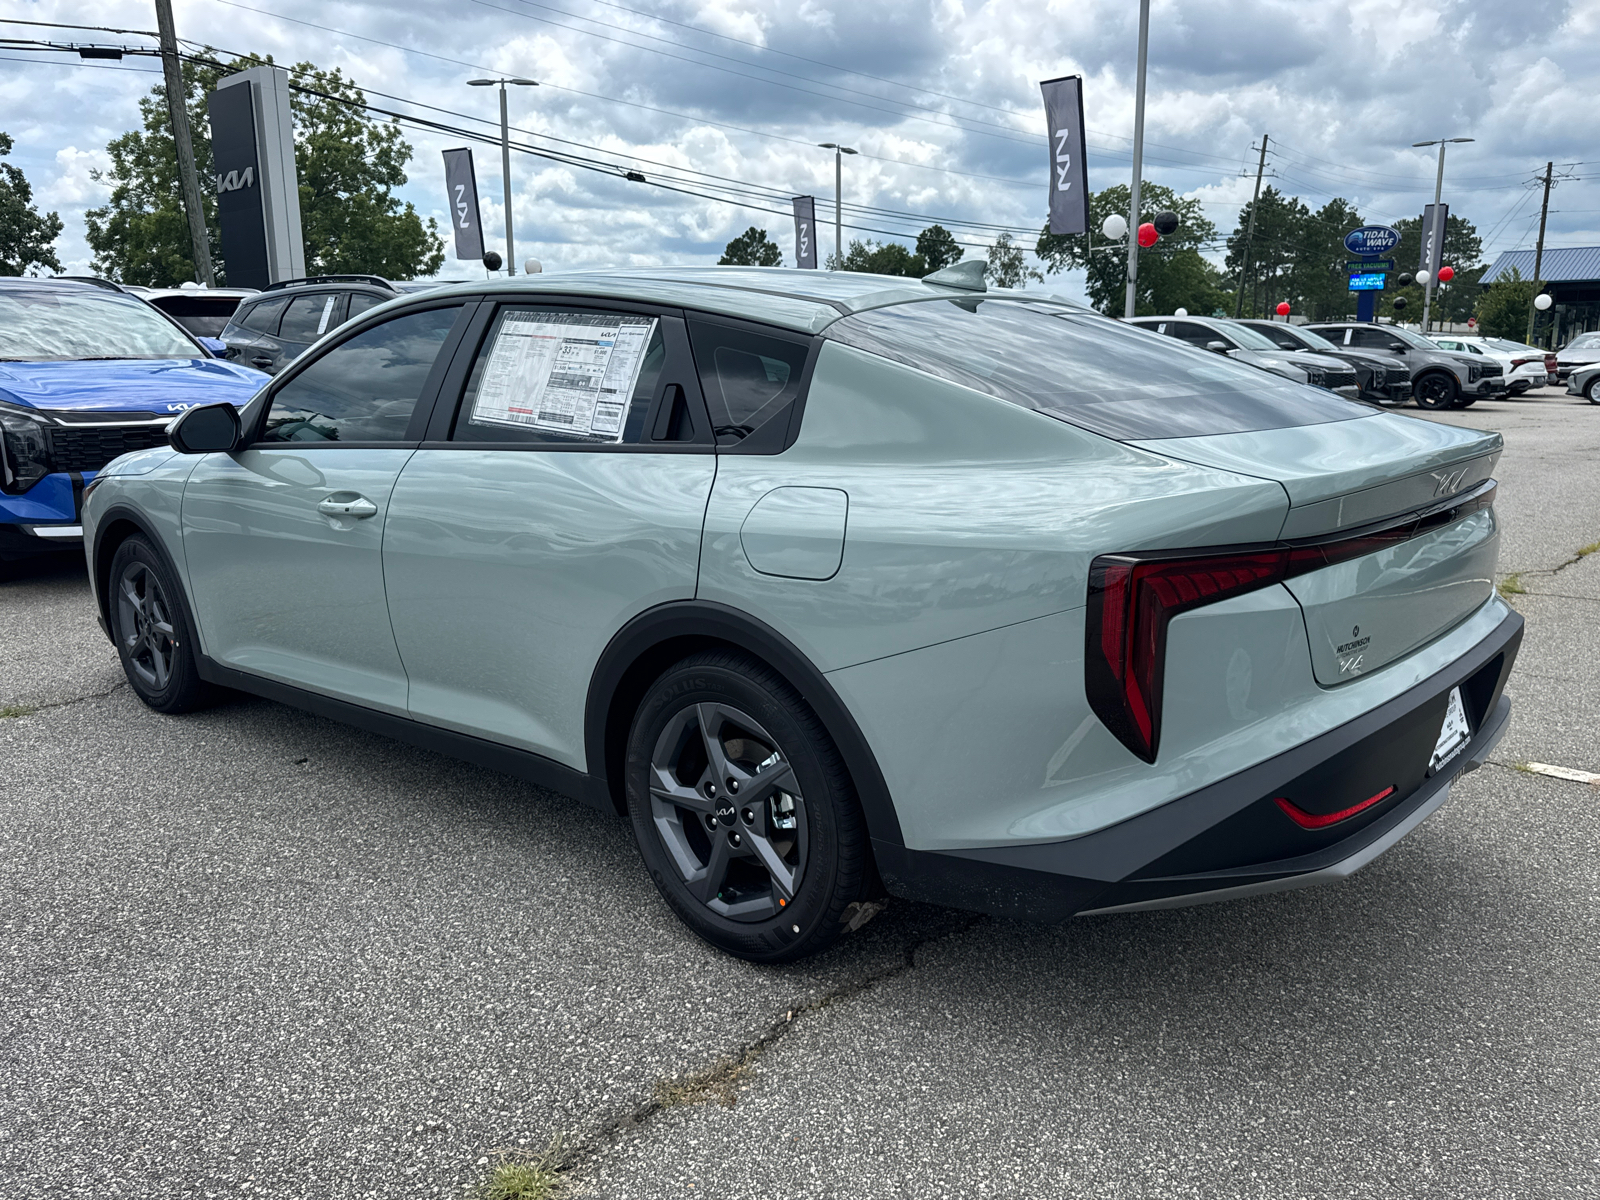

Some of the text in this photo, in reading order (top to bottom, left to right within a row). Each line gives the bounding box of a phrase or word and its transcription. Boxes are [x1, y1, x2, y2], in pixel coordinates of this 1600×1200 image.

[1055, 128, 1072, 191] KIA
[217, 166, 254, 193] KIA
[455, 184, 470, 229] KIA
[1363, 230, 1390, 239] TIDAL
[1366, 237, 1395, 247] WAVE
[562, 345, 572, 354] 33
[1336, 635, 1371, 654] HUTCHINSON
[654, 678, 706, 710] SOLUS
[716, 806, 735, 816] KIA
[812, 801, 825, 852] 205/55
